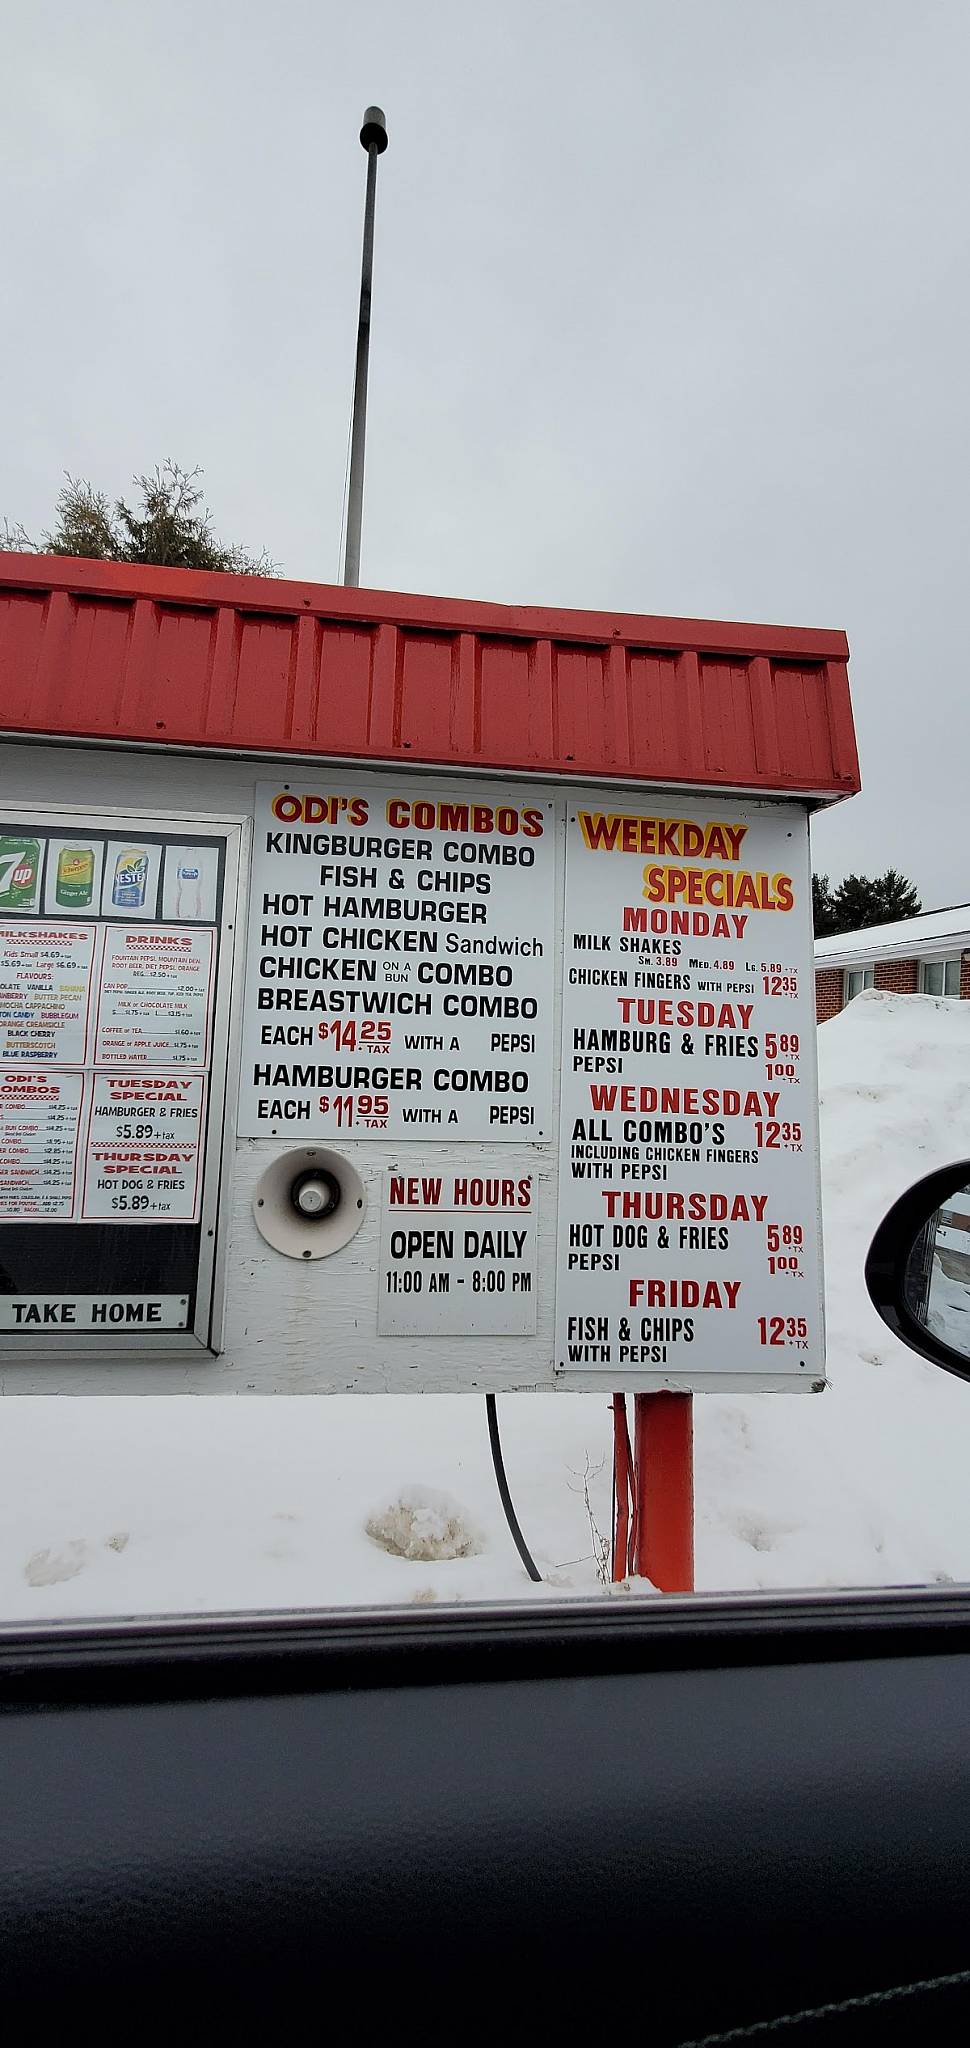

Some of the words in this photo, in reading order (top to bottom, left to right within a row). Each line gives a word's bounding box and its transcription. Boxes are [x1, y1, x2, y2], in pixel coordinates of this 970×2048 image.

[272, 793, 369, 827] ODI'S
[386, 799, 545, 838] COMBOS
[266, 832, 433, 861] KINGBURGER
[443, 841, 535, 867] COMBO
[578, 811, 749, 861] WEEKDAY
[320, 865, 377, 889] FISH
[389, 868, 405, 890] &
[417, 870, 491, 895] CHIPS
[642, 863, 794, 912] SPECIALS
[262, 893, 313, 916] HOT
[323, 896, 487, 925] HAMBURGER
[623, 906, 748, 939] MONDAY
[126, 935, 192, 946] DRINKS
[261, 925, 312, 948] HOT
[322, 927, 438, 953] CHICKEN
[445, 933, 543, 957] Sandwich
[573, 934, 611, 951] MILK
[619, 937, 682, 955] SHAKES
[259, 956, 376, 981] CHICKEN
[383, 961, 399, 970] ON
[404, 962, 412, 971] A
[385, 973, 408, 983] BUN
[418, 962, 513, 987] COMBO
[656, 956, 678, 967] 3.89
[713, 960, 735, 971] 4.89
[761, 963, 782, 973] 5.89
[569, 968, 627, 987] CHICKEN
[634, 971, 691, 991] FINGERS
[697, 981, 723, 994] WITH
[727, 982, 755, 994] PEPSI
[257, 988, 432, 1015] BREASTWICH
[443, 994, 538, 1020] COMBO
[617, 997, 754, 1030] TUESDAY
[261, 1025, 313, 1046] EACH
[404, 1035, 443, 1051] WITH
[450, 1036, 460, 1051] A
[490, 1033, 535, 1053] PEPSI
[573, 1028, 671, 1054] HAMBURG
[681, 1033, 695, 1055] &
[705, 1034, 759, 1058] FRIES
[253, 1063, 422, 1092] HAMBURGER
[433, 1068, 529, 1093] COMBO
[573, 1055, 623, 1074] PEPSI
[107, 1080, 193, 1089] TUESDAY
[110, 1091, 188, 1101] SPECIAL
[94, 1105, 156, 1118] HAMBURGER
[160, 1107, 167, 1117] &
[170, 1108, 198, 1118] FRIES
[257, 1098, 310, 1121] EACH
[402, 1108, 442, 1124] WITH
[448, 1109, 458, 1124] A
[489, 1105, 534, 1125] PEPSI
[590, 1084, 781, 1118] WEDNESDAY
[572, 1118, 613, 1142] ALL
[623, 1119, 725, 1145] COMBO'S
[92, 1153, 194, 1162] THURSDAY
[571, 1145, 639, 1160] INCLUDING
[645, 1146, 700, 1162] CHICKEN
[706, 1148, 759, 1164] FINGERS
[103, 1165, 182, 1174] SPECIAL
[571, 1162, 613, 1179] WITH
[621, 1163, 667, 1181] PEPSI
[97, 1179, 118, 1190] HOT
[122, 1180, 143, 1190] DOG
[147, 1180, 154, 1190] &
[157, 1180, 185, 1190] FRIES
[389, 1177, 442, 1205] NEW
[454, 1178, 532, 1207] HOURS
[601, 1190, 768, 1222] THURSDAY
[390, 1230, 454, 1259] OPEN
[464, 1230, 528, 1259] DAILY
[569, 1223, 604, 1248] HOT
[612, 1224, 648, 1249] DOG
[657, 1225, 670, 1249] &
[679, 1226, 729, 1250] FRIES
[568, 1253, 620, 1271] PEPSI
[386, 1270, 422, 1293] 11:00
[429, 1272, 450, 1293] AM
[472, 1270, 506, 1293] 8:00
[512, 1272, 532, 1292] PM
[629, 1279, 742, 1309] FRIDAY
[12, 1303, 76, 1323] TAKE
[91, 1303, 162, 1323] HOME
[567, 1316, 609, 1341] FISH
[618, 1316, 631, 1342] &
[640, 1317, 695, 1343] CHIPS
[568, 1345, 611, 1362] WITH
[619, 1345, 667, 1363] PEPSI
